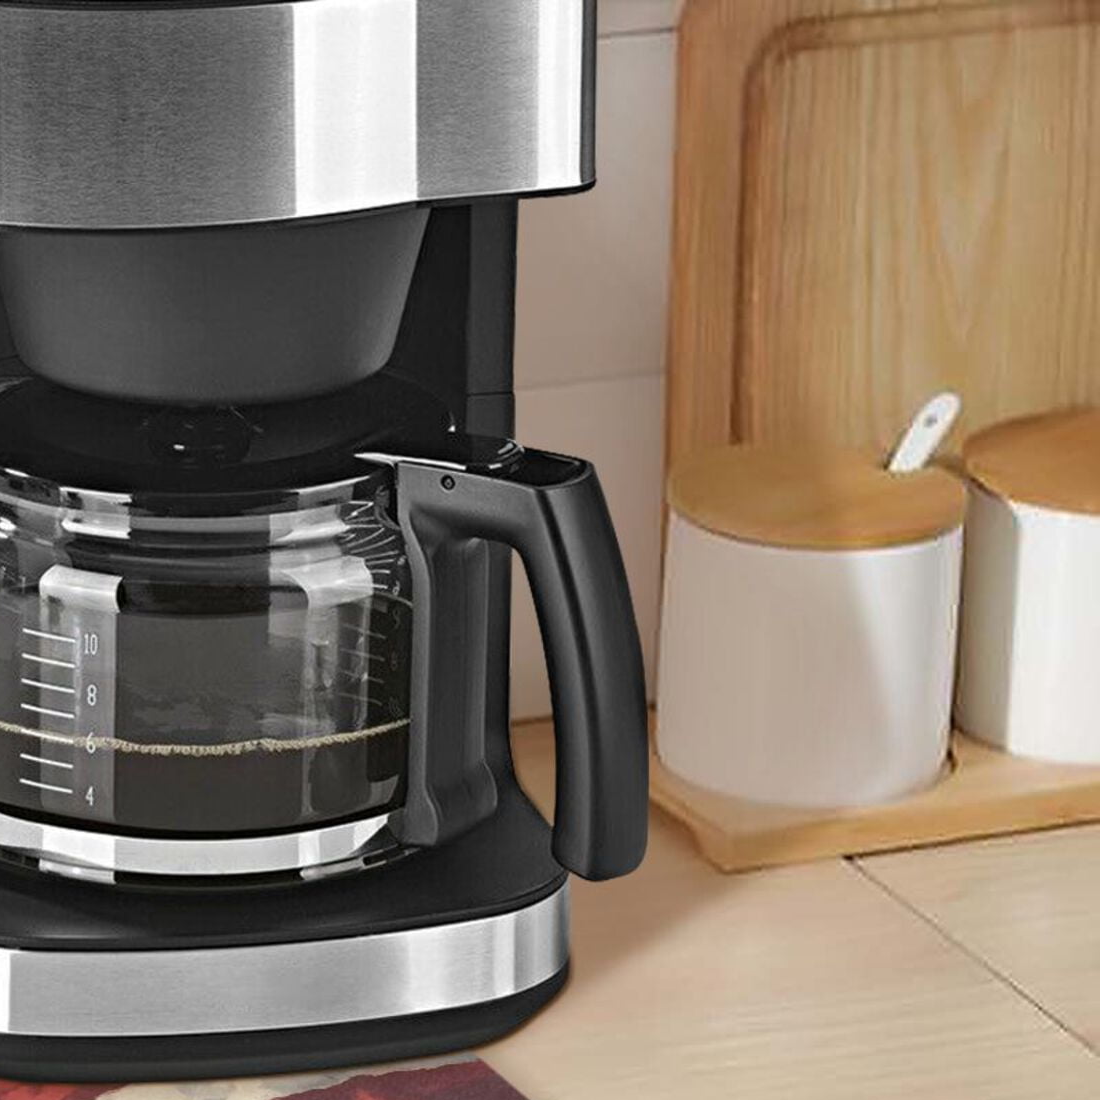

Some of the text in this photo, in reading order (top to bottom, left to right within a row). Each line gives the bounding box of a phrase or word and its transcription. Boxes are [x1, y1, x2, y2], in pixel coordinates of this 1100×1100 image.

[84, 633, 98, 655] 10
[87, 684, 97, 706] 8
[86, 731, 96, 754] 6
[85, 785, 94, 806] 4
